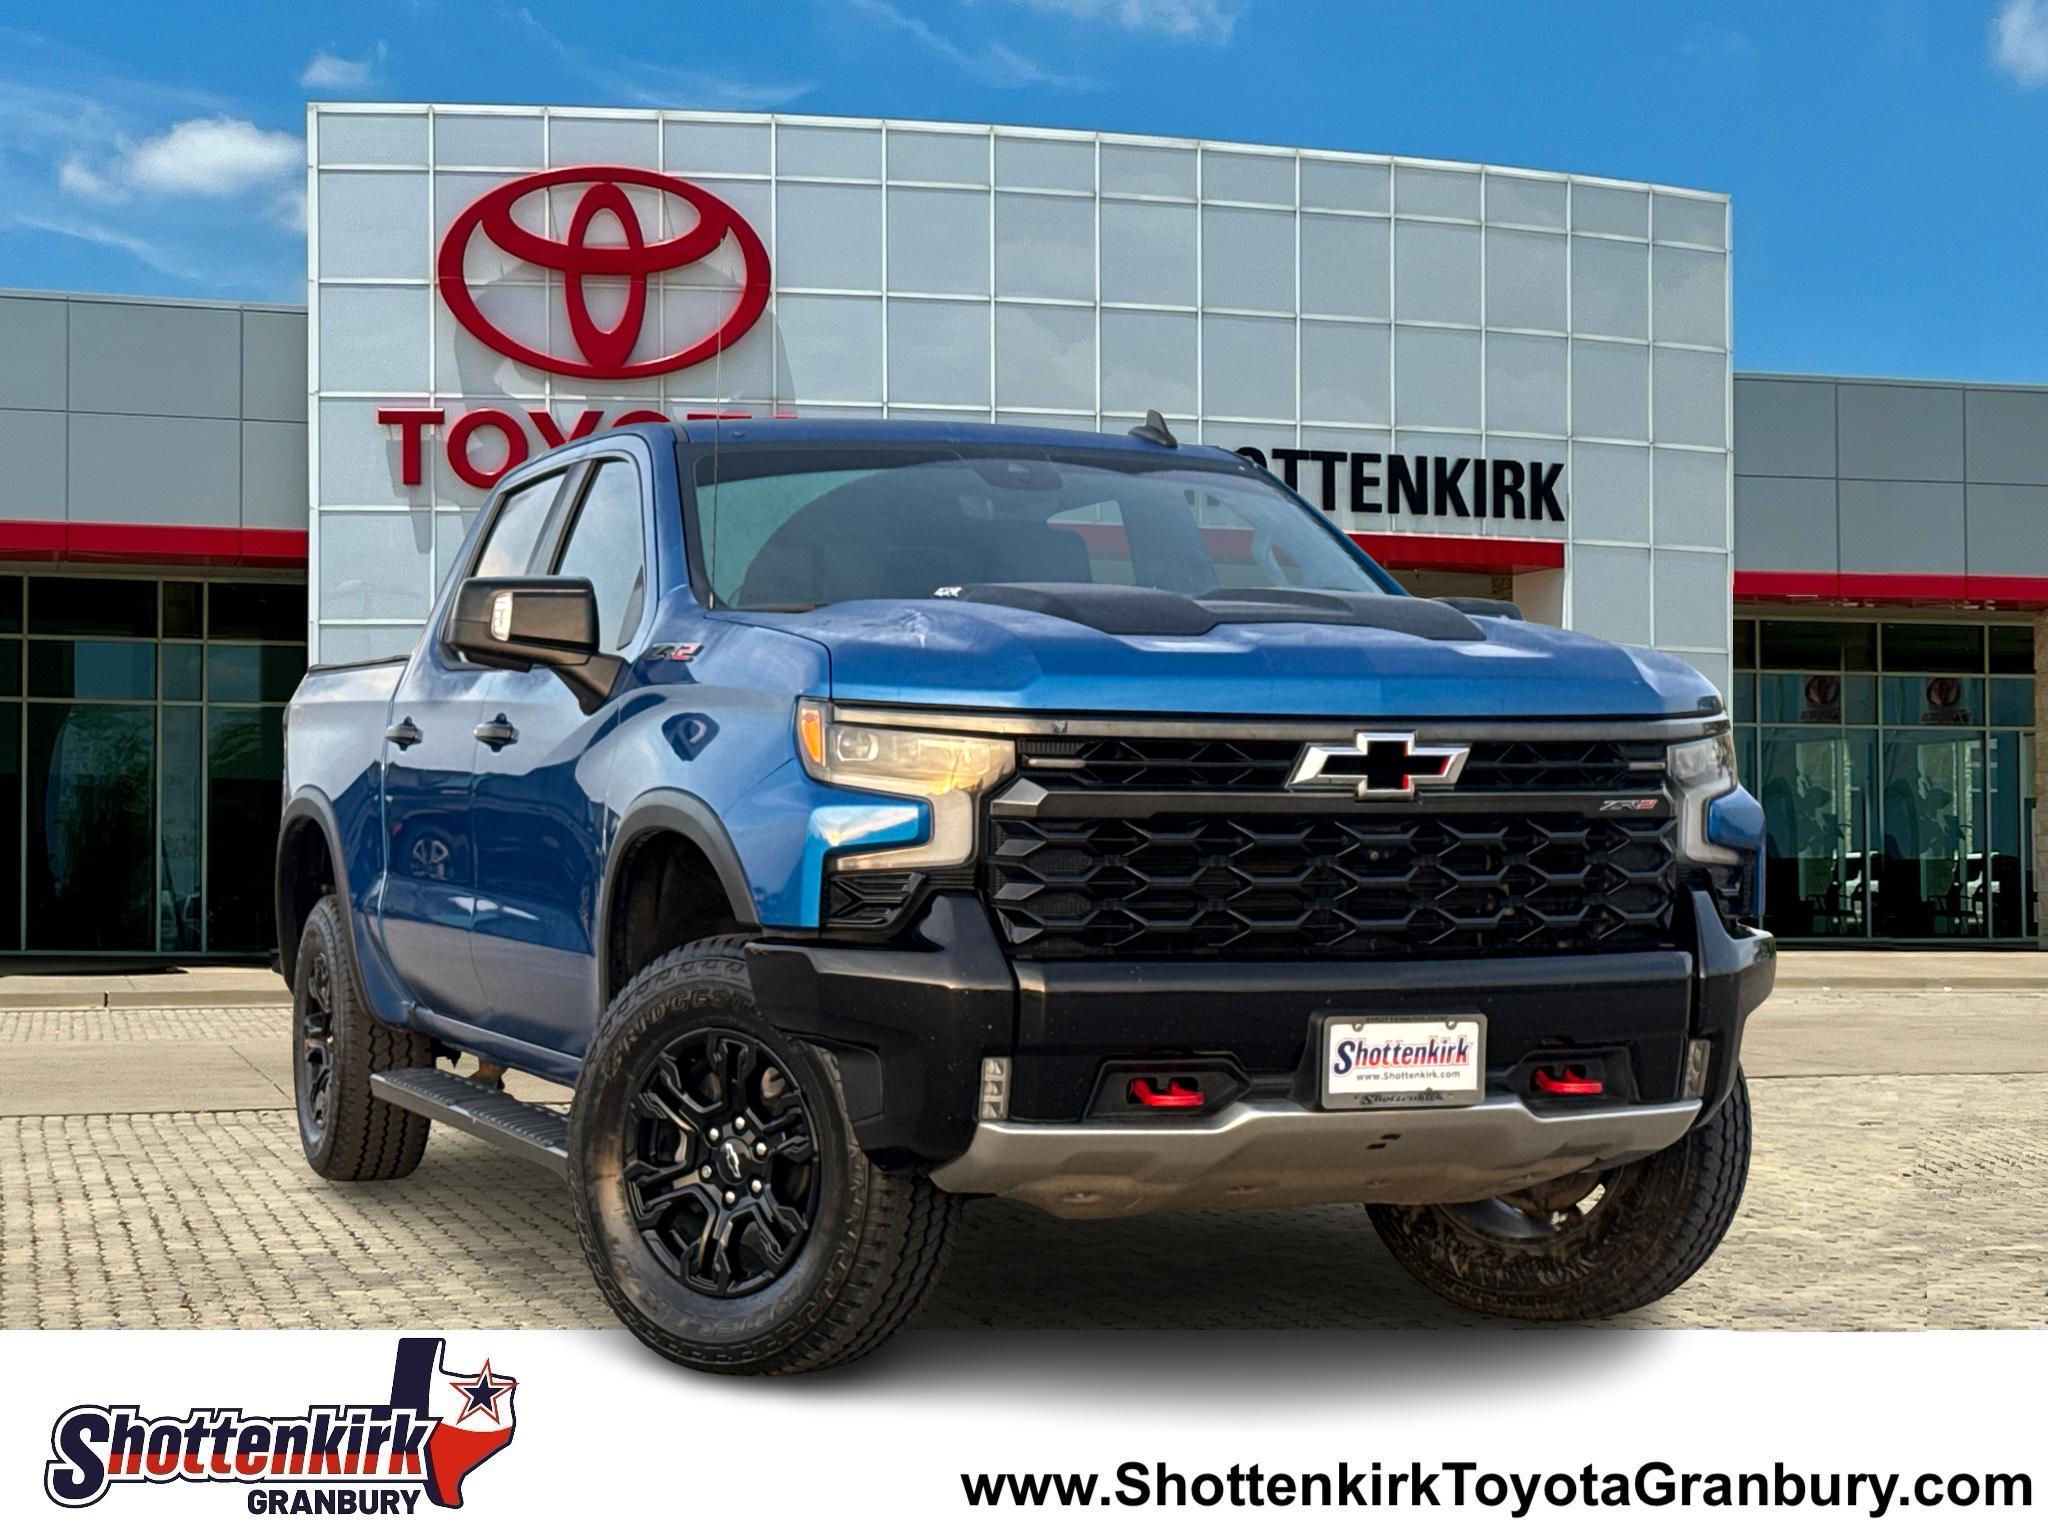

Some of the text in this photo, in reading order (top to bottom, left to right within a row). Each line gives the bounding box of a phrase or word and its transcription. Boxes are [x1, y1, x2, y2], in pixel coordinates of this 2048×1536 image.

[377, 407, 798, 490] TOY
[1236, 447, 1565, 522] TTENKIRK
[1333, 1036, 1471, 1076] Shottenkirk
[1356, 1070, 1461, 1081] www.Shottenkirk.com
